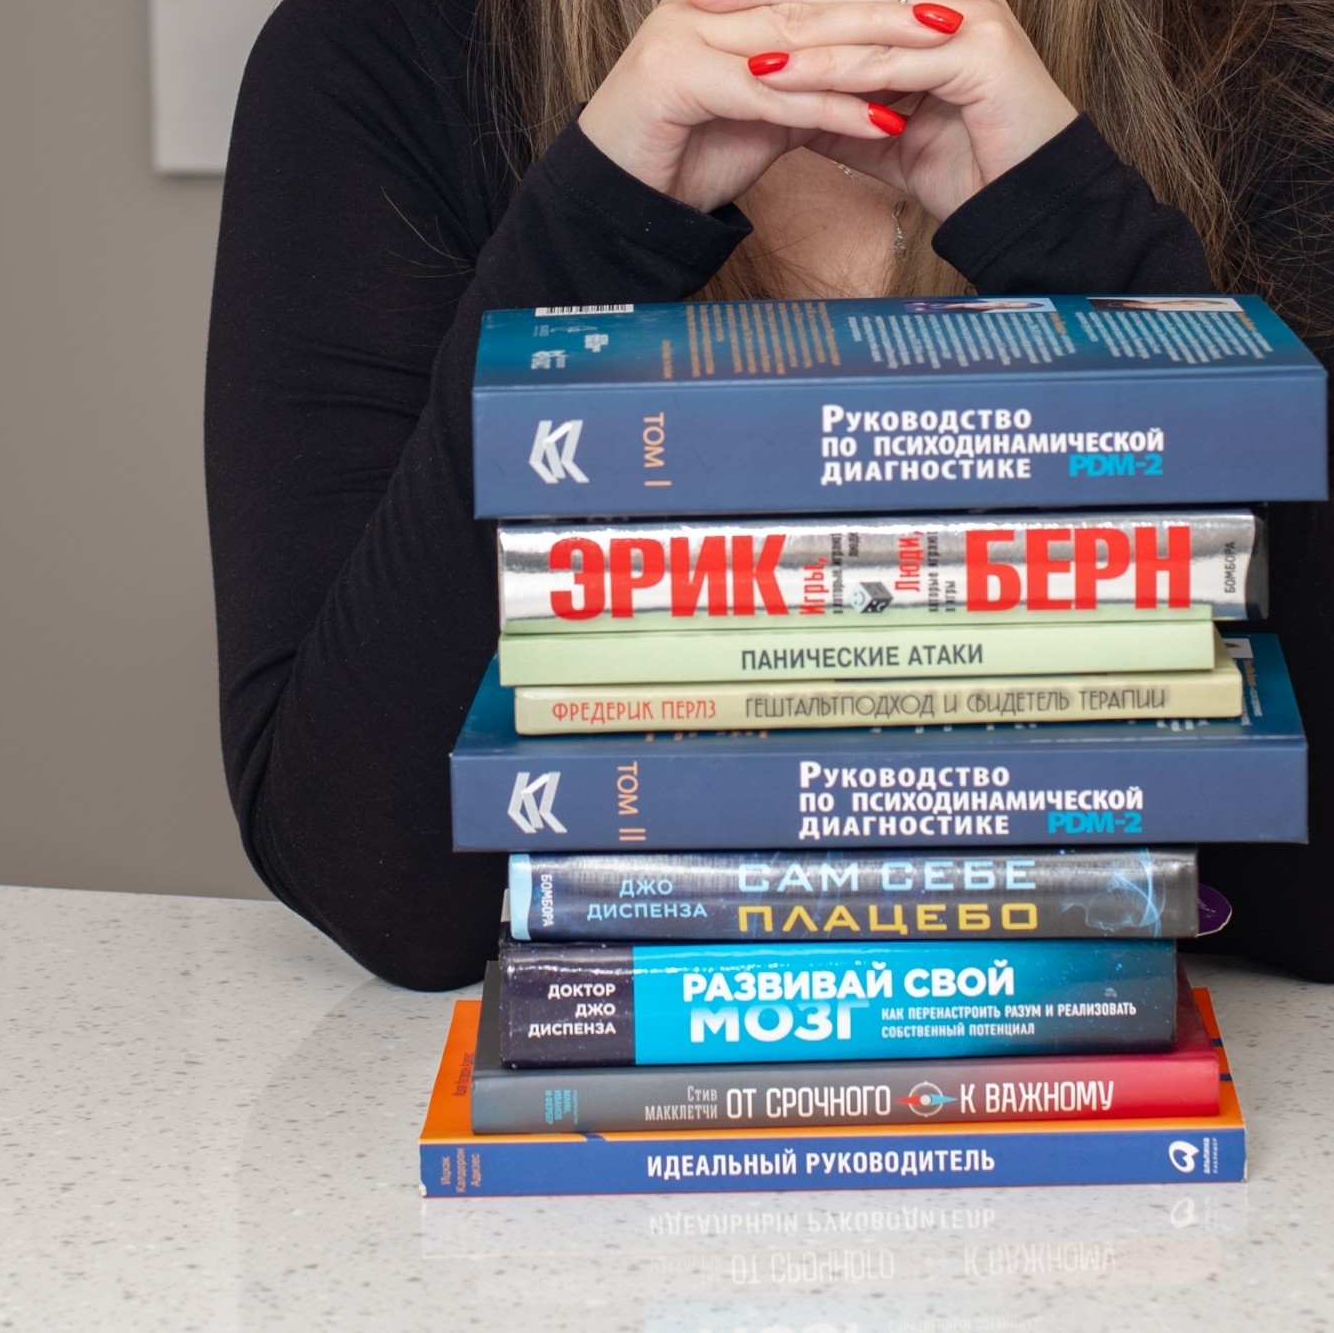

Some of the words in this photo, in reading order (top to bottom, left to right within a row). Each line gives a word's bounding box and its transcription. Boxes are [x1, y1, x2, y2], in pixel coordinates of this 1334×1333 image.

[642, 411, 665, 468] ТОМ
[821, 436, 857, 458] ПО
[873, 427, 1165, 458] ПСИХОДИНАМИЧЕСКОЙ
[820, 458, 1032, 486] ДИАГНОСТИКЕ
[1068, 453, 1164, 478] PDM-2
[547, 534, 790, 621] ЭРИК
[964, 525, 1191, 612] БЕРН
[894, 531, 924, 592] Люди,
[1224, 541, 1237, 594] БОМБОРА
[798, 557, 829, 615] Игры,
[928, 572, 941, 612] которые
[945, 580, 958, 605] игры
[741, 646, 900, 670] ПАНИЧЕСКИЕ
[908, 644, 984, 666] АТАКИ
[552, 701, 655, 725] ФРЕДЕРИК
[661, 699, 717, 720] ПЕРЛЗ
[745, 694, 935, 719] ГЕШТАЛЬТПОДХОД
[943, 693, 958, 715] И
[966, 690, 1070, 716] СВИДЕТЕЛЬ
[1080, 689, 1166, 711] ТЕРАПИИ
[617, 761, 639, 815] ТОМ
[798, 792, 835, 813] ПО
[852, 786, 1144, 814] ПСИХОДИНАМИЧЕСКОЙ
[619, 827, 646, 842] II
[798, 815, 1010, 840] ДИАГНОСТИКЕ
[1047, 810, 1143, 834] PDM-2
[619, 879, 673, 898] ДЖО
[738, 862, 859, 892] САМ
[881, 859, 1037, 891] СЕБЕ
[540, 874, 554, 928] БОМБОРА
[587, 903, 708, 921] ДИСПЕНЗА
[738, 902, 1038, 936] ПЛАЦЕБО
[547, 982, 617, 999] ДОКТОР
[683, 961, 893, 1002] РАЗВИВАЙ
[903, 959, 1015, 998] СВОЙ
[575, 1002, 617, 1018] ДЖО
[689, 999, 870, 1043] МОЗГ
[881, 1007, 905, 1021] КАК
[908, 1005, 1001, 1020] ПЕРЕНАСТРОИТЬ
[1004, 1004, 1042, 1019] РАЗУМ
[1045, 1003, 1055, 1017] И
[1057, 1002, 1138, 1017] РЕАЛИЗОВАТЬ
[528, 1021, 617, 1038] ДИСПЕНЗА
[881, 1023, 966, 1039] СОБСТВЕННЫЙ
[968, 1022, 1035, 1038] ПОТЕНЦИАЛ
[644, 1102, 719, 1121] МАККЛЕТЧИ
[726, 1088, 757, 1119] ОТ
[766, 1084, 892, 1118] СРОЧНОГО
[960, 1084, 976, 1114] К
[985, 1080, 1115, 1113] ВАЖНОМУ
[647, 1149, 797, 1180] ИДЕАЛЬНЫЙ
[806, 1149, 995, 1177] РУКОВОДИТЕЛЬ
